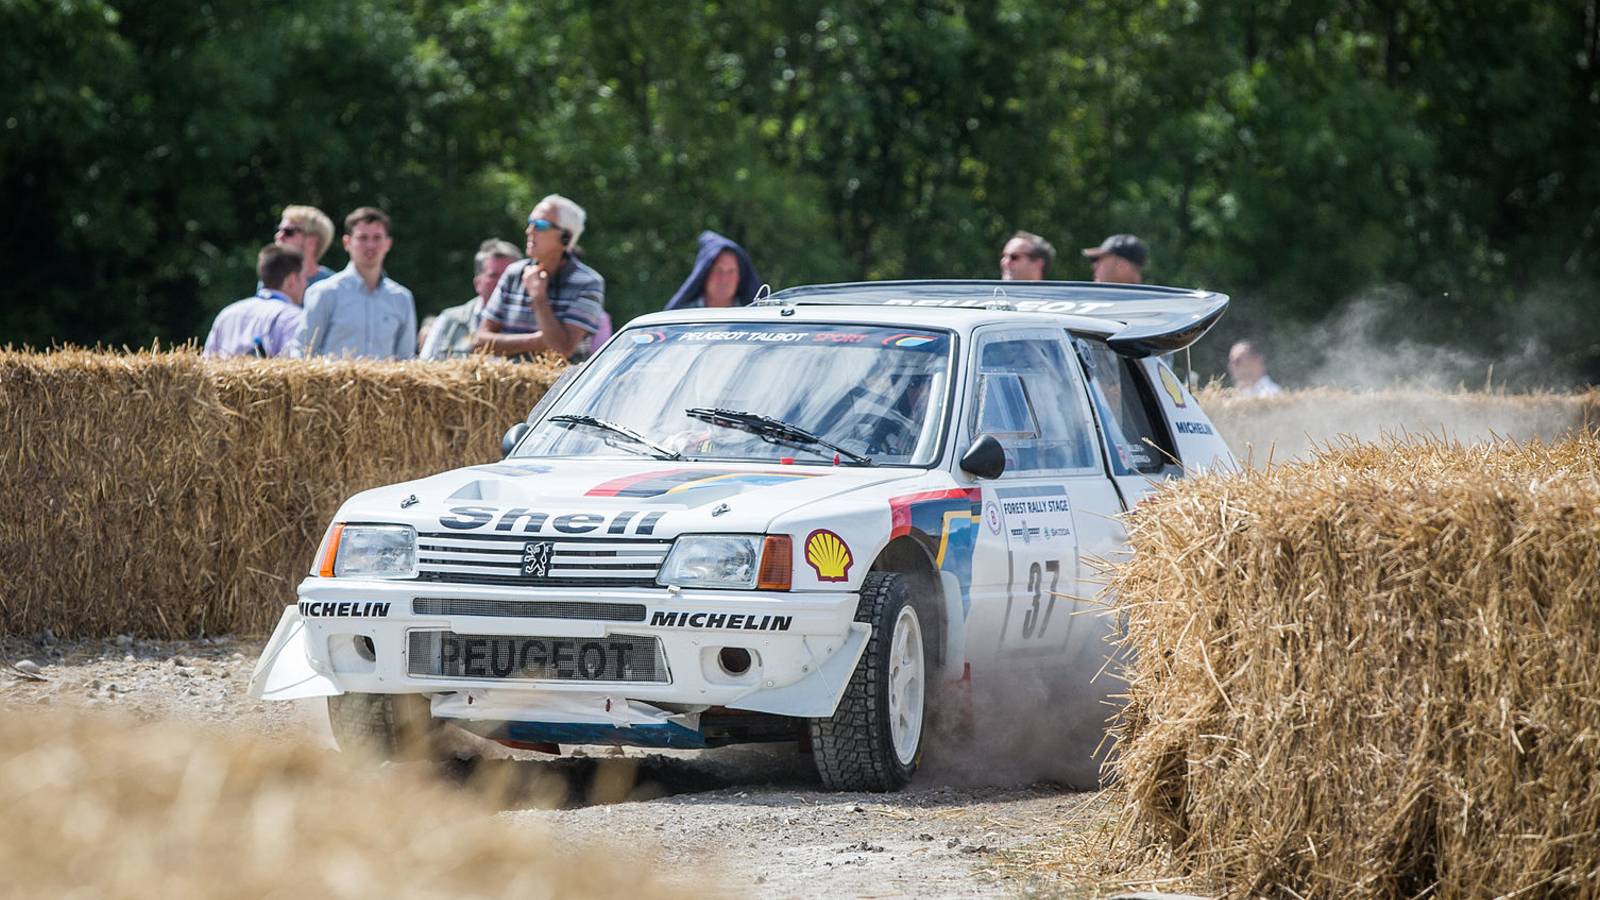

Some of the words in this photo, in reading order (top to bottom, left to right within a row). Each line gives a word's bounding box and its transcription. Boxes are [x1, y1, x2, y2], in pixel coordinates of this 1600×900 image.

[678, 331, 749, 342] PEUGEOT
[747, 331, 809, 342] TALBOT
[812, 332, 869, 343] SPORT
[1003, 502, 1028, 515] FOREST
[1027, 500, 1048, 514] RALLY
[1047, 499, 1069, 512] STAGE
[439, 505, 668, 536] Shell
[1022, 559, 1060, 640] 37
[650, 611, 793, 631] MICHELIN
[441, 638, 634, 681] PEUGEOT
